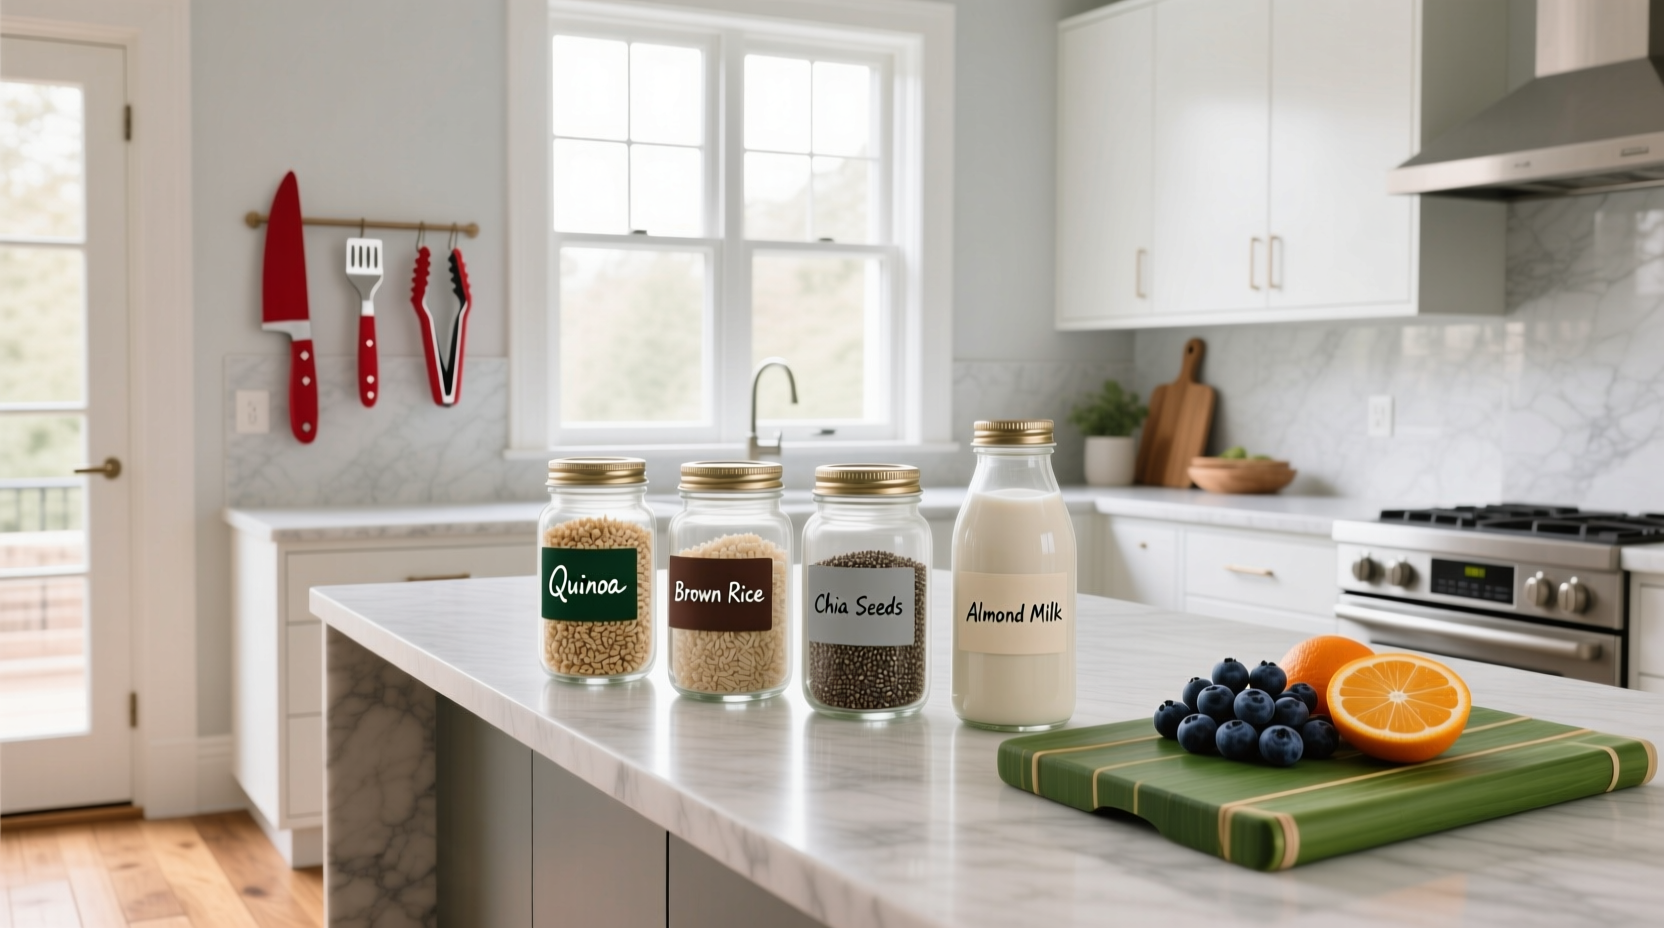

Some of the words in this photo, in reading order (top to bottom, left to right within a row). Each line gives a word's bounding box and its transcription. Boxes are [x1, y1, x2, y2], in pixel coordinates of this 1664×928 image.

[548, 564, 627, 603] Quinoa
[674, 580, 721, 602] Brown
[728, 581, 765, 603] Rice
[814, 592, 848, 615] Chia
[855, 595, 903, 616] Seeds
[966, 601, 1024, 623] Almond
[1029, 601, 1062, 622] Milk
